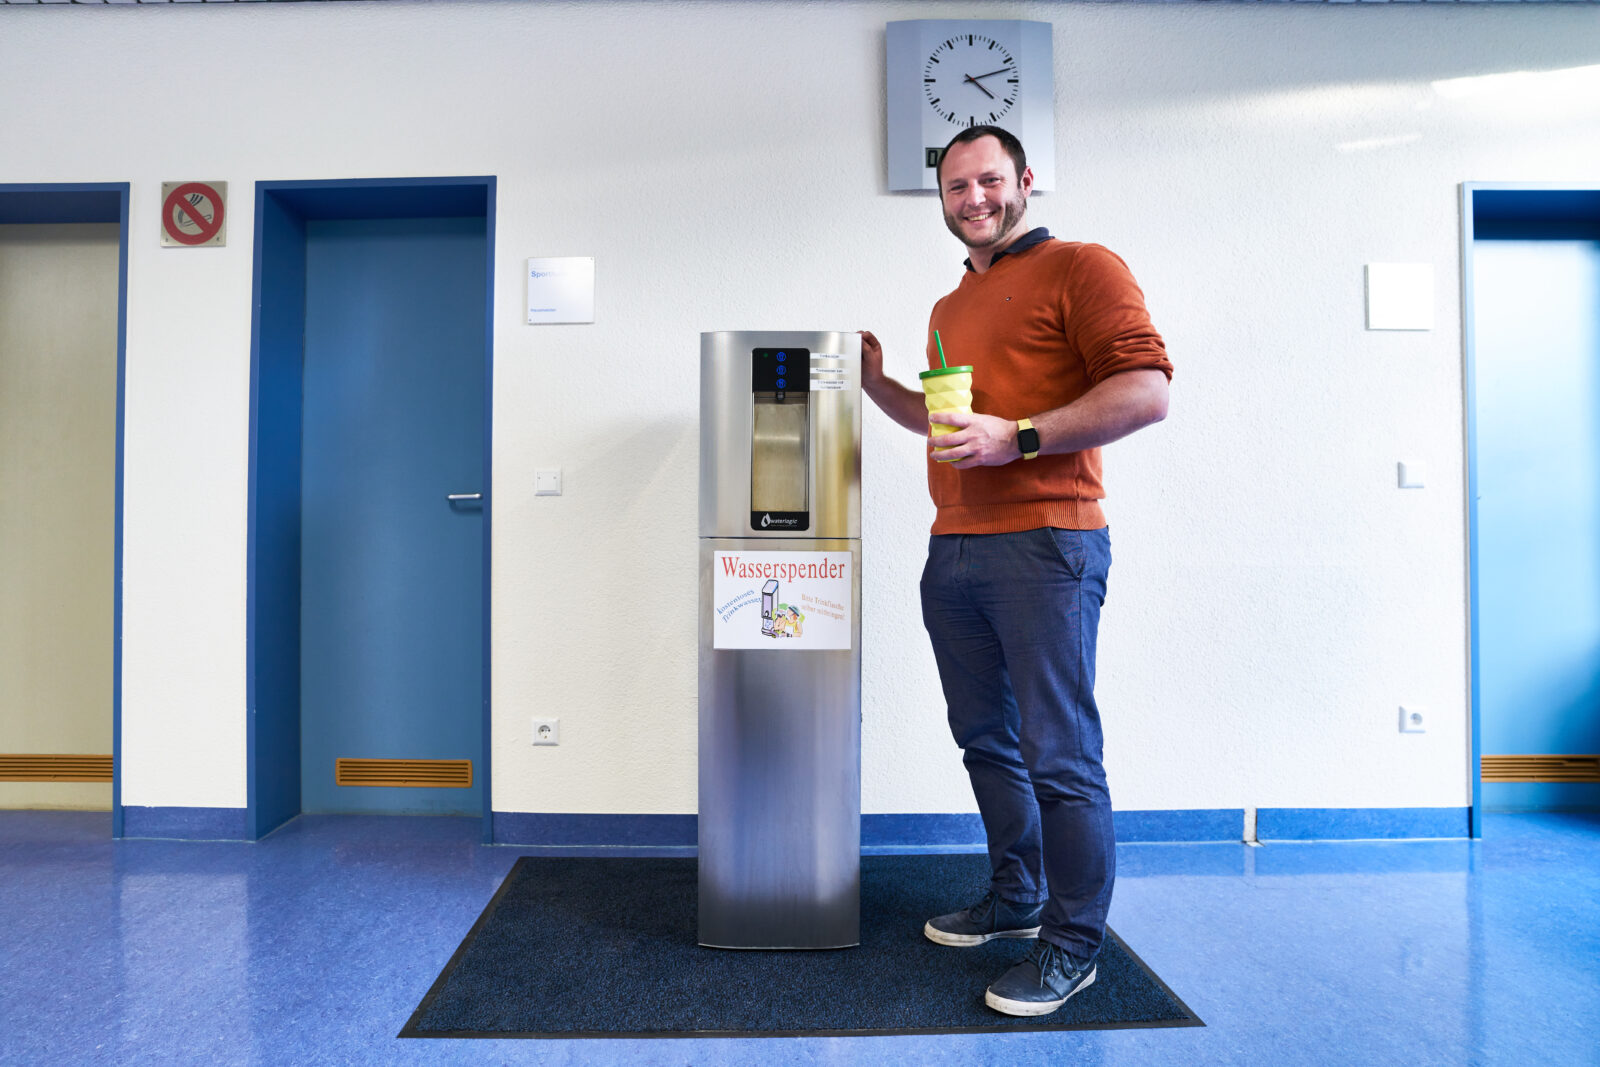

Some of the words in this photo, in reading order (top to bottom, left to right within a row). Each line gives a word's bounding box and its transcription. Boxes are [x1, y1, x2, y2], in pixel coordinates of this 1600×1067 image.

[721, 556, 846, 583] Wasserspender
[716, 589, 755, 615] kostenloses
[722, 597, 762, 624] Trinkwasser
